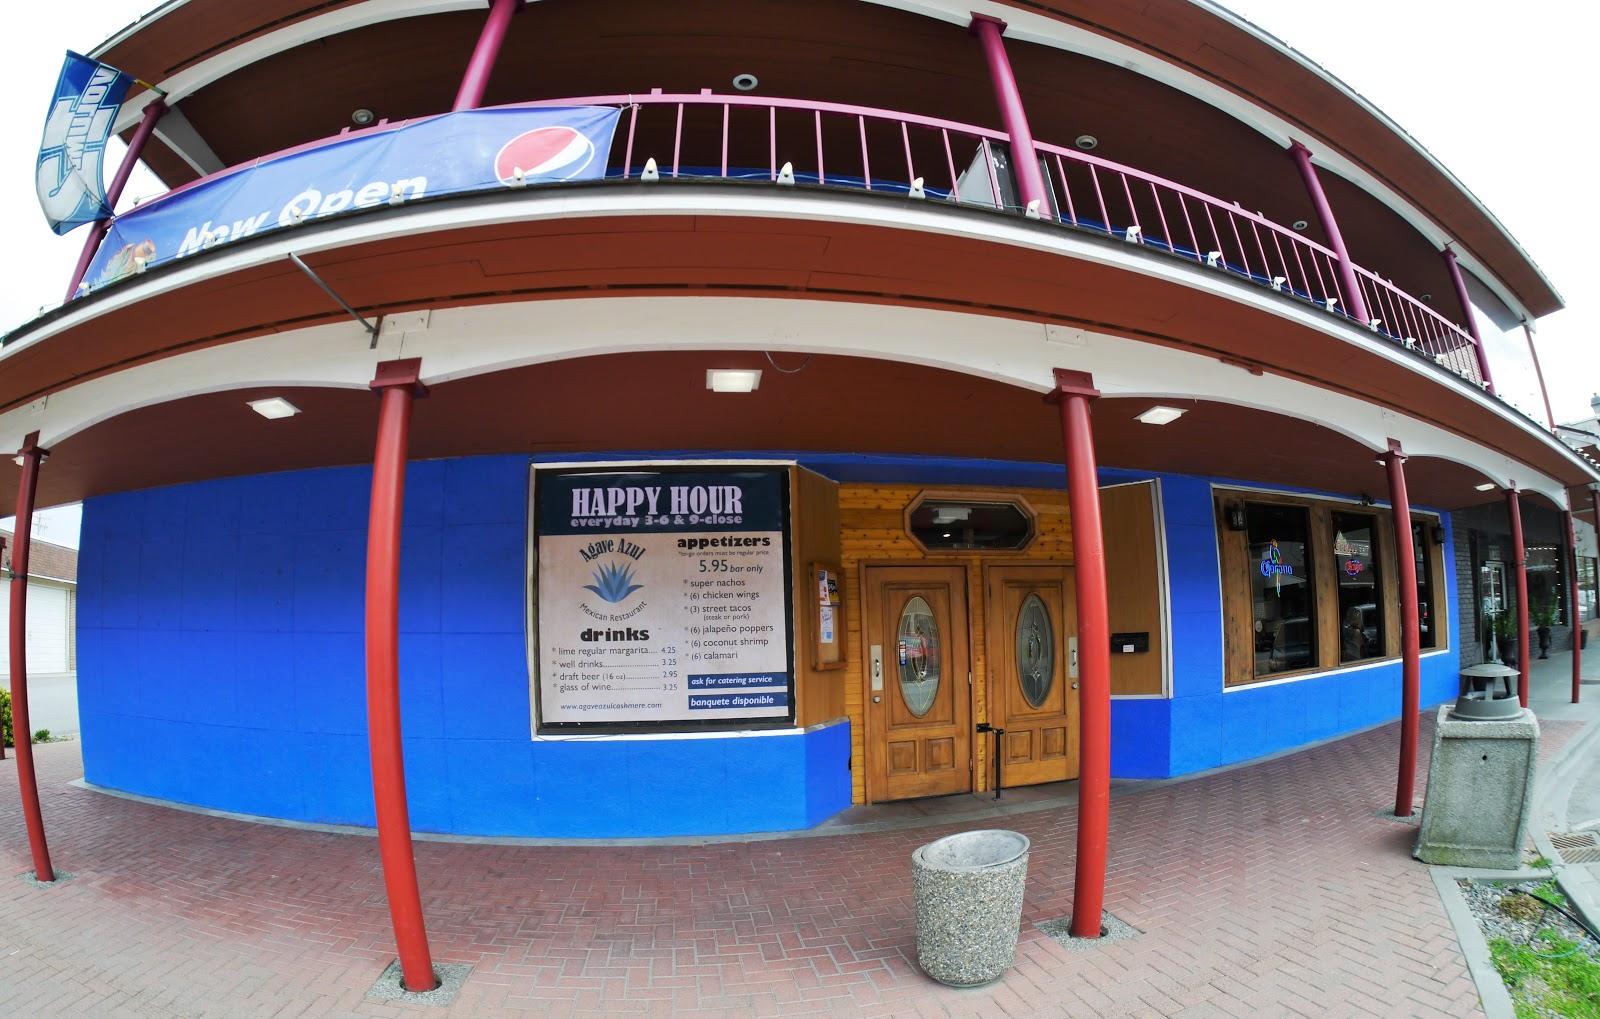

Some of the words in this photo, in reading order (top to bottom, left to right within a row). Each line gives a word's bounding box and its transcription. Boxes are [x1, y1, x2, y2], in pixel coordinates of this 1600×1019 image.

[176, 211, 271, 258] Now
[278, 176, 428, 226] Open
[571, 486, 662, 517] HAPPY
[669, 485, 743, 515] HOUR
[570, 515, 640, 528] everyday
[644, 515, 669, 526] 3-6
[673, 514, 685, 525] &
[689, 514, 743, 525] 9-close
[677, 536, 771, 549] appetizers
[579, 539, 614, 563] Agave
[617, 538, 646, 560] Azul
[699, 559, 728, 572] 5.95
[746, 564, 764, 574] only
[1260, 560, 1293, 578] Corona
[690, 580, 714, 589] super
[716, 578, 746, 587] nachos
[689, 592, 700, 600] (6)
[702, 591, 734, 599] chicken
[736, 591, 760, 600] wings
[580, 602, 608, 621] Mexican
[610, 601, 648, 622] Restaurant
[689, 606, 700, 614] (3)
[580, 627, 650, 642] drinks
[690, 626, 701, 635] (6)
[739, 625, 774, 634] poppers
[691, 639, 701, 648] (6)
[703, 639, 738, 647] coconut
[740, 637, 769, 647] shrimp
[558, 647, 576, 655] lime
[578, 647, 607, 657] regular
[691, 653, 701, 661] (6)
[703, 652, 738, 660] calamari
[559, 660, 576, 668] well
[559, 672, 579, 681] draft
[581, 672, 600, 680] beer
[705, 677, 716, 686] for
[718, 676, 747, 685] catering
[559, 683, 579, 693] glass
[581, 682, 590, 691] of
[690, 697, 730, 708] banquete
[732, 696, 774, 706] disponible
